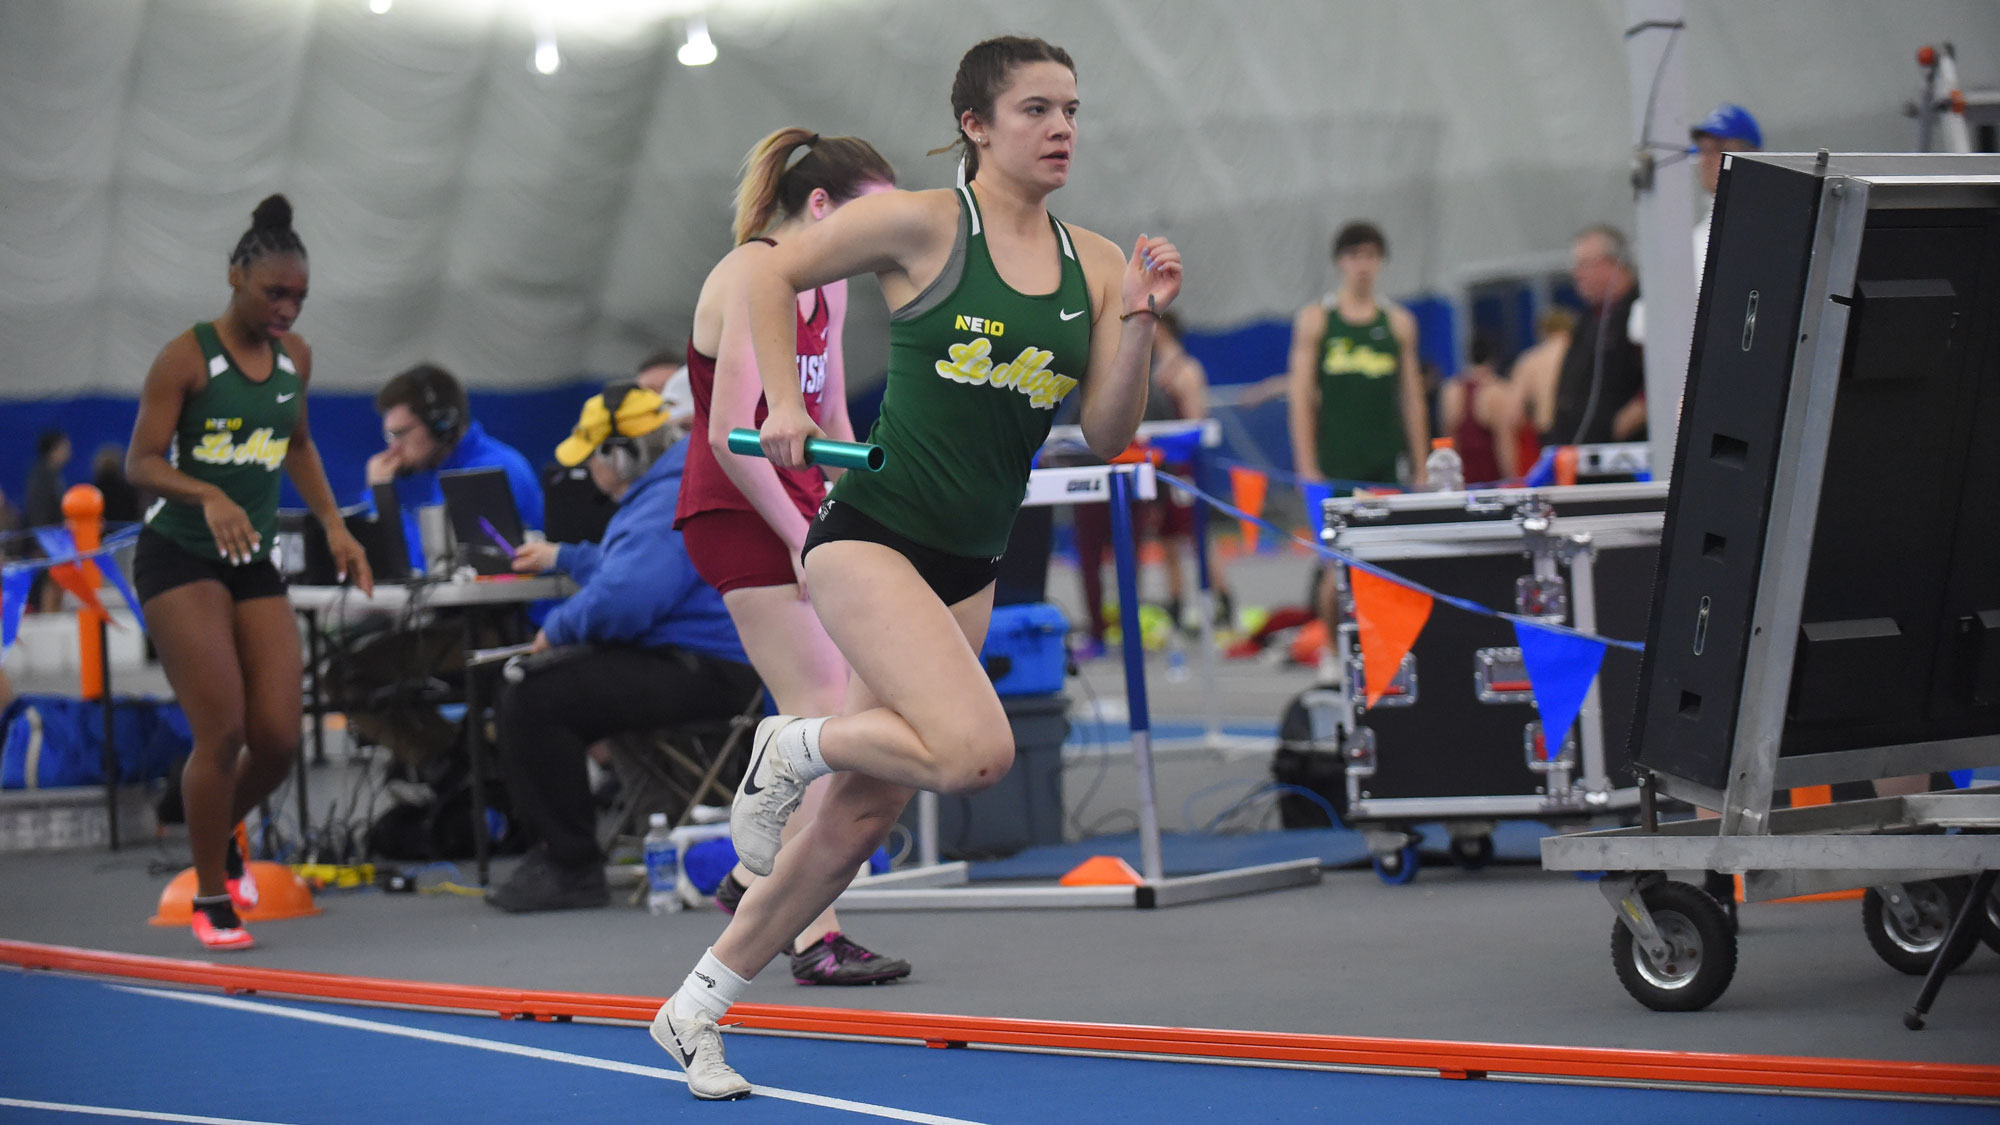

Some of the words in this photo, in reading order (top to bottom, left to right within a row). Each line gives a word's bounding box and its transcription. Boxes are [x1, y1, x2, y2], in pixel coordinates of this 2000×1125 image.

[954, 314, 1005, 337] NE10
[935, 337, 994, 386] Le
[192, 431, 235, 465] Le
